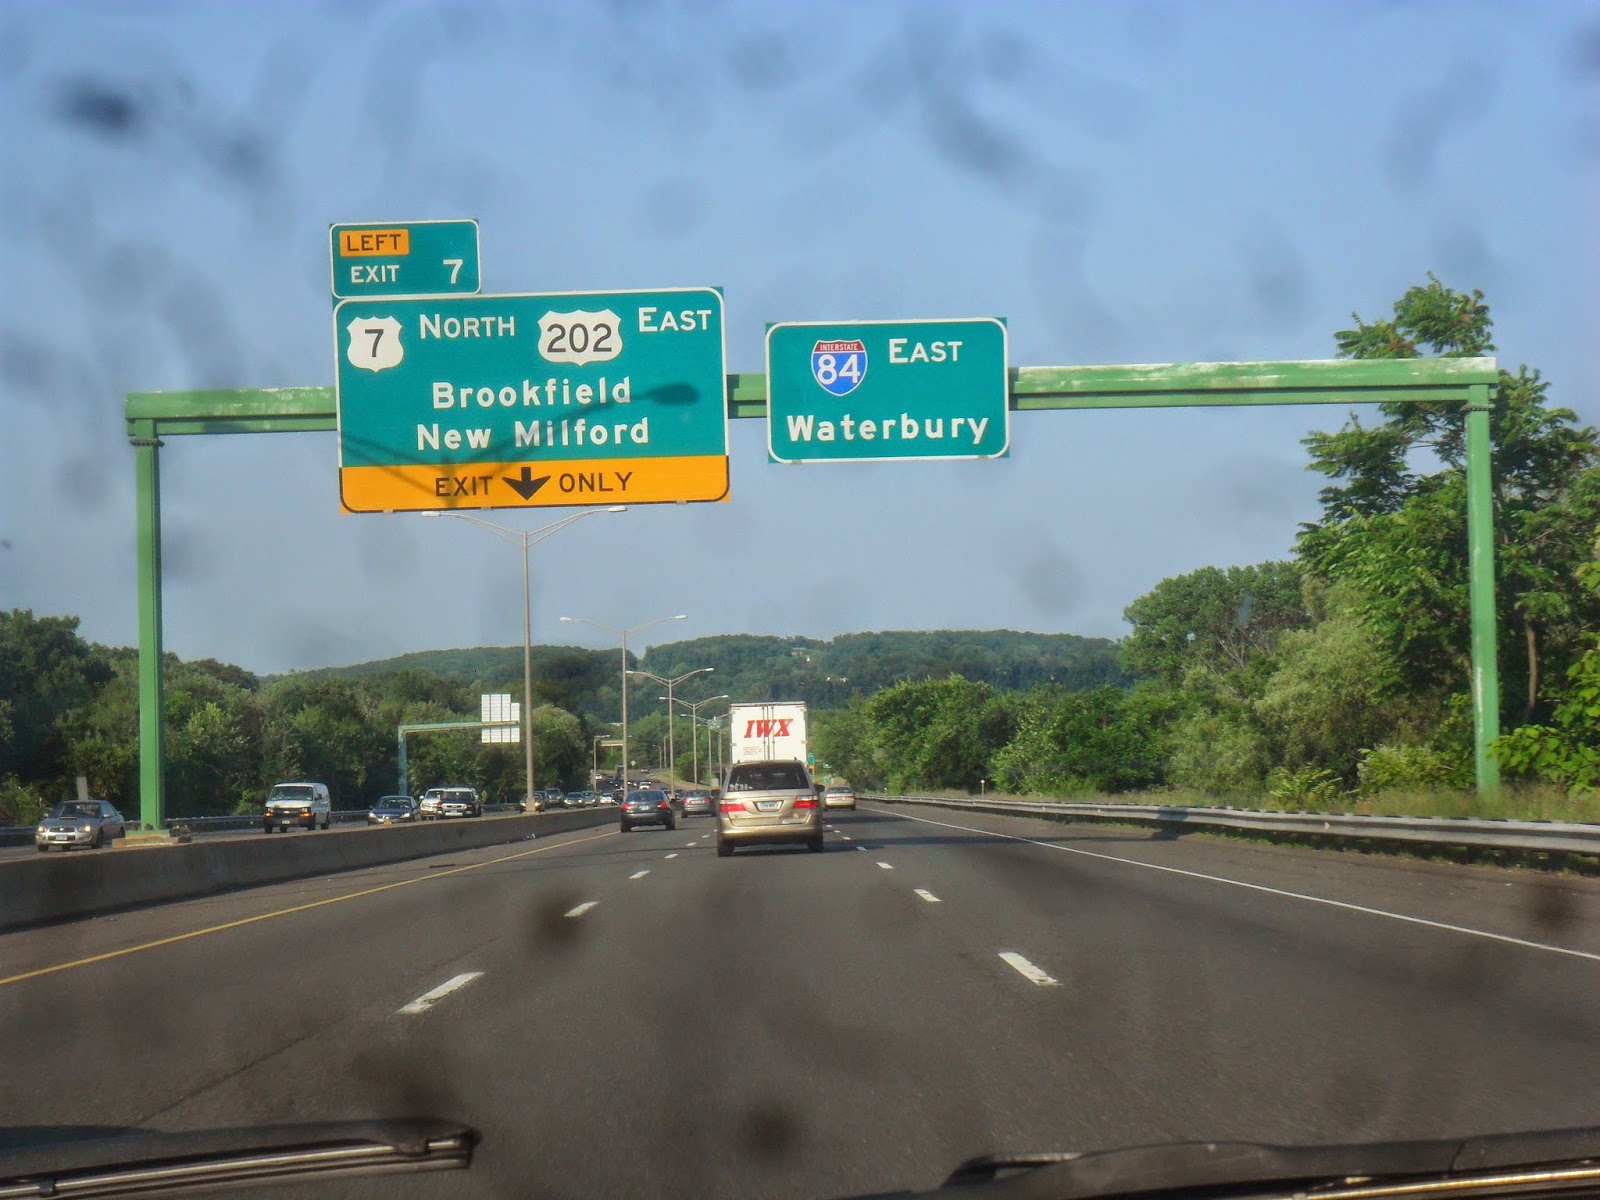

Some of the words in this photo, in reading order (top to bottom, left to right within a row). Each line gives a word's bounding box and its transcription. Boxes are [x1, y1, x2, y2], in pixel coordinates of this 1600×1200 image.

[346, 233, 402, 252] LEFT
[350, 264, 400, 283] EXIT
[442, 259, 464, 285] 7
[364, 328, 385, 358] 7
[419, 313, 516, 339] NORTH
[546, 322, 613, 353] 202
[638, 307, 712, 333] EAST
[819, 343, 859, 351] INTERSTATE
[817, 353, 861, 385] 84
[889, 338, 963, 364] EAST
[432, 376, 631, 409] Brookfield
[417, 423, 492, 451] New
[515, 417, 649, 447] Milford
[786, 412, 989, 445] Waterbury
[435, 476, 493, 498] EXIT
[558, 471, 633, 493] ONLY
[744, 718, 793, 738] IWX
